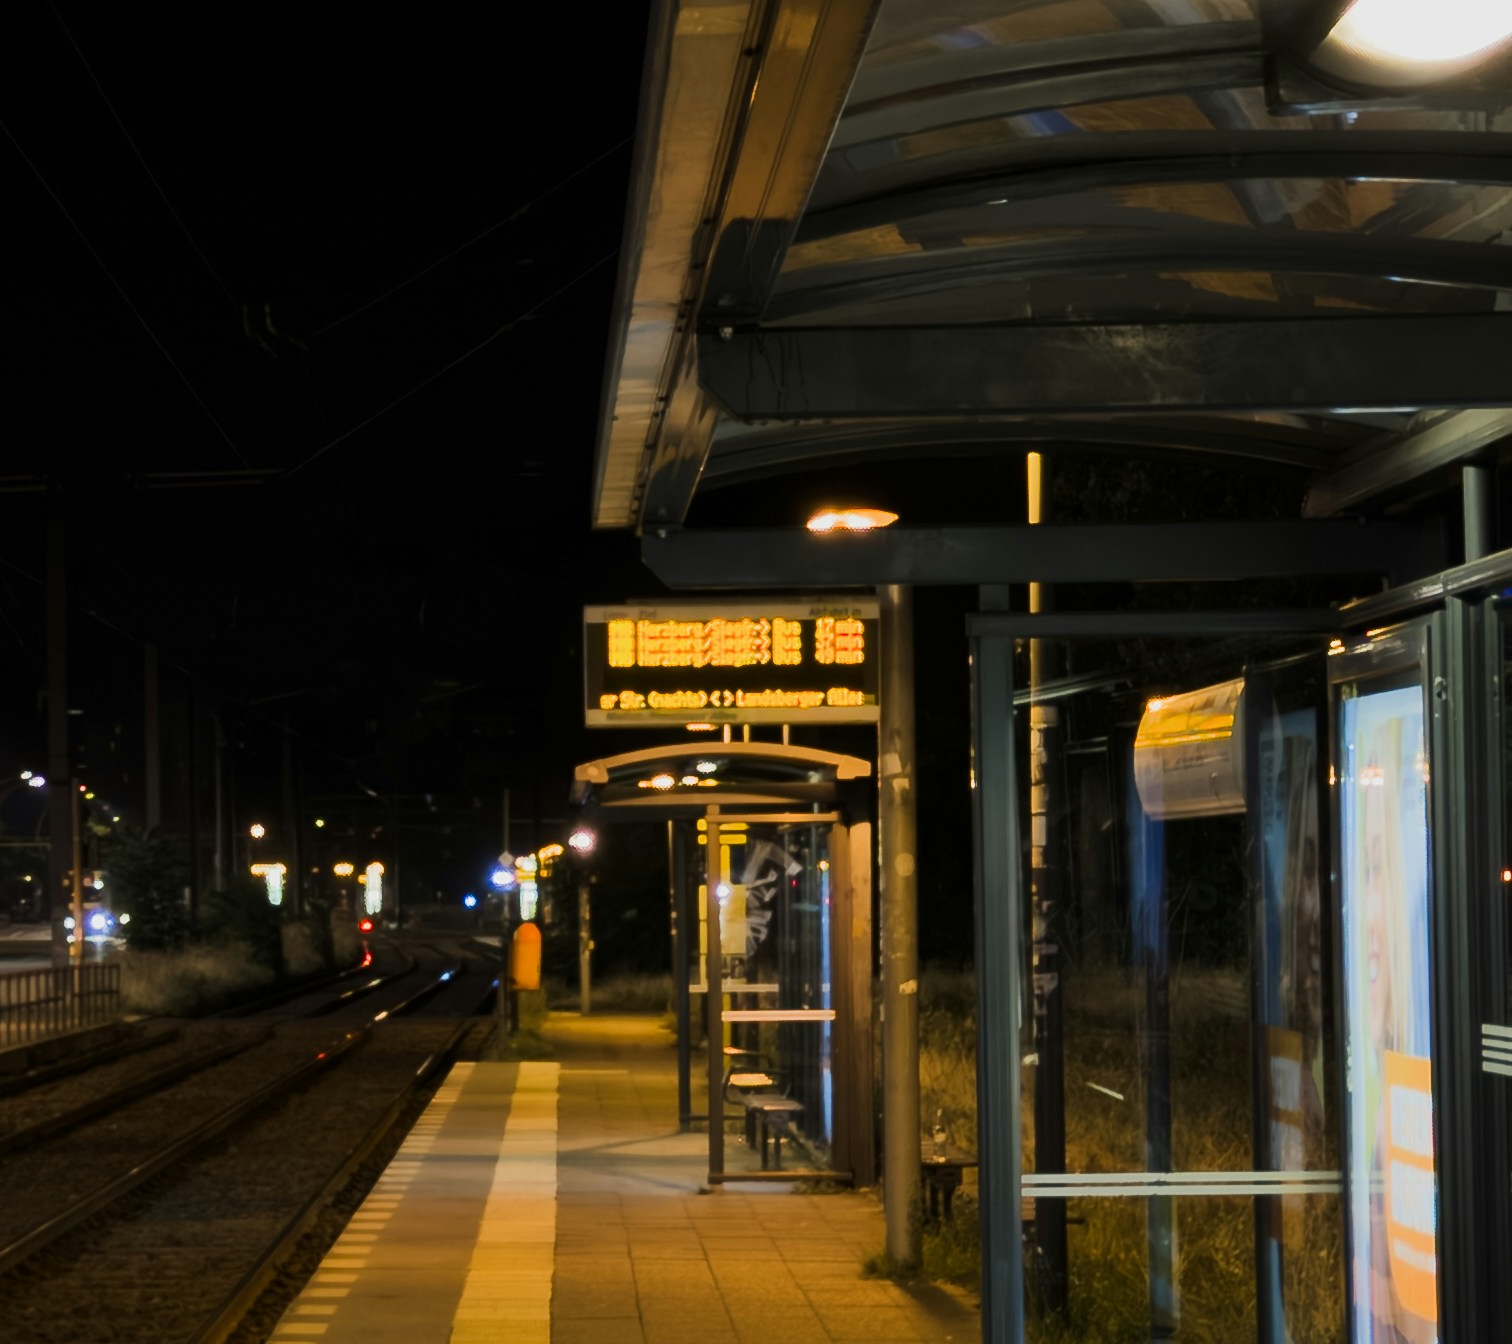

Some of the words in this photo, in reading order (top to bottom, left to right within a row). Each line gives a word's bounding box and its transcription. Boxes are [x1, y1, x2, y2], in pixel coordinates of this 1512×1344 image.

[835, 619, 865, 634] min
[835, 634, 865, 649] min
[835, 649, 865, 664] min
[620, 690, 646, 709] Str.
[736, 688, 825, 709] Landsberger
